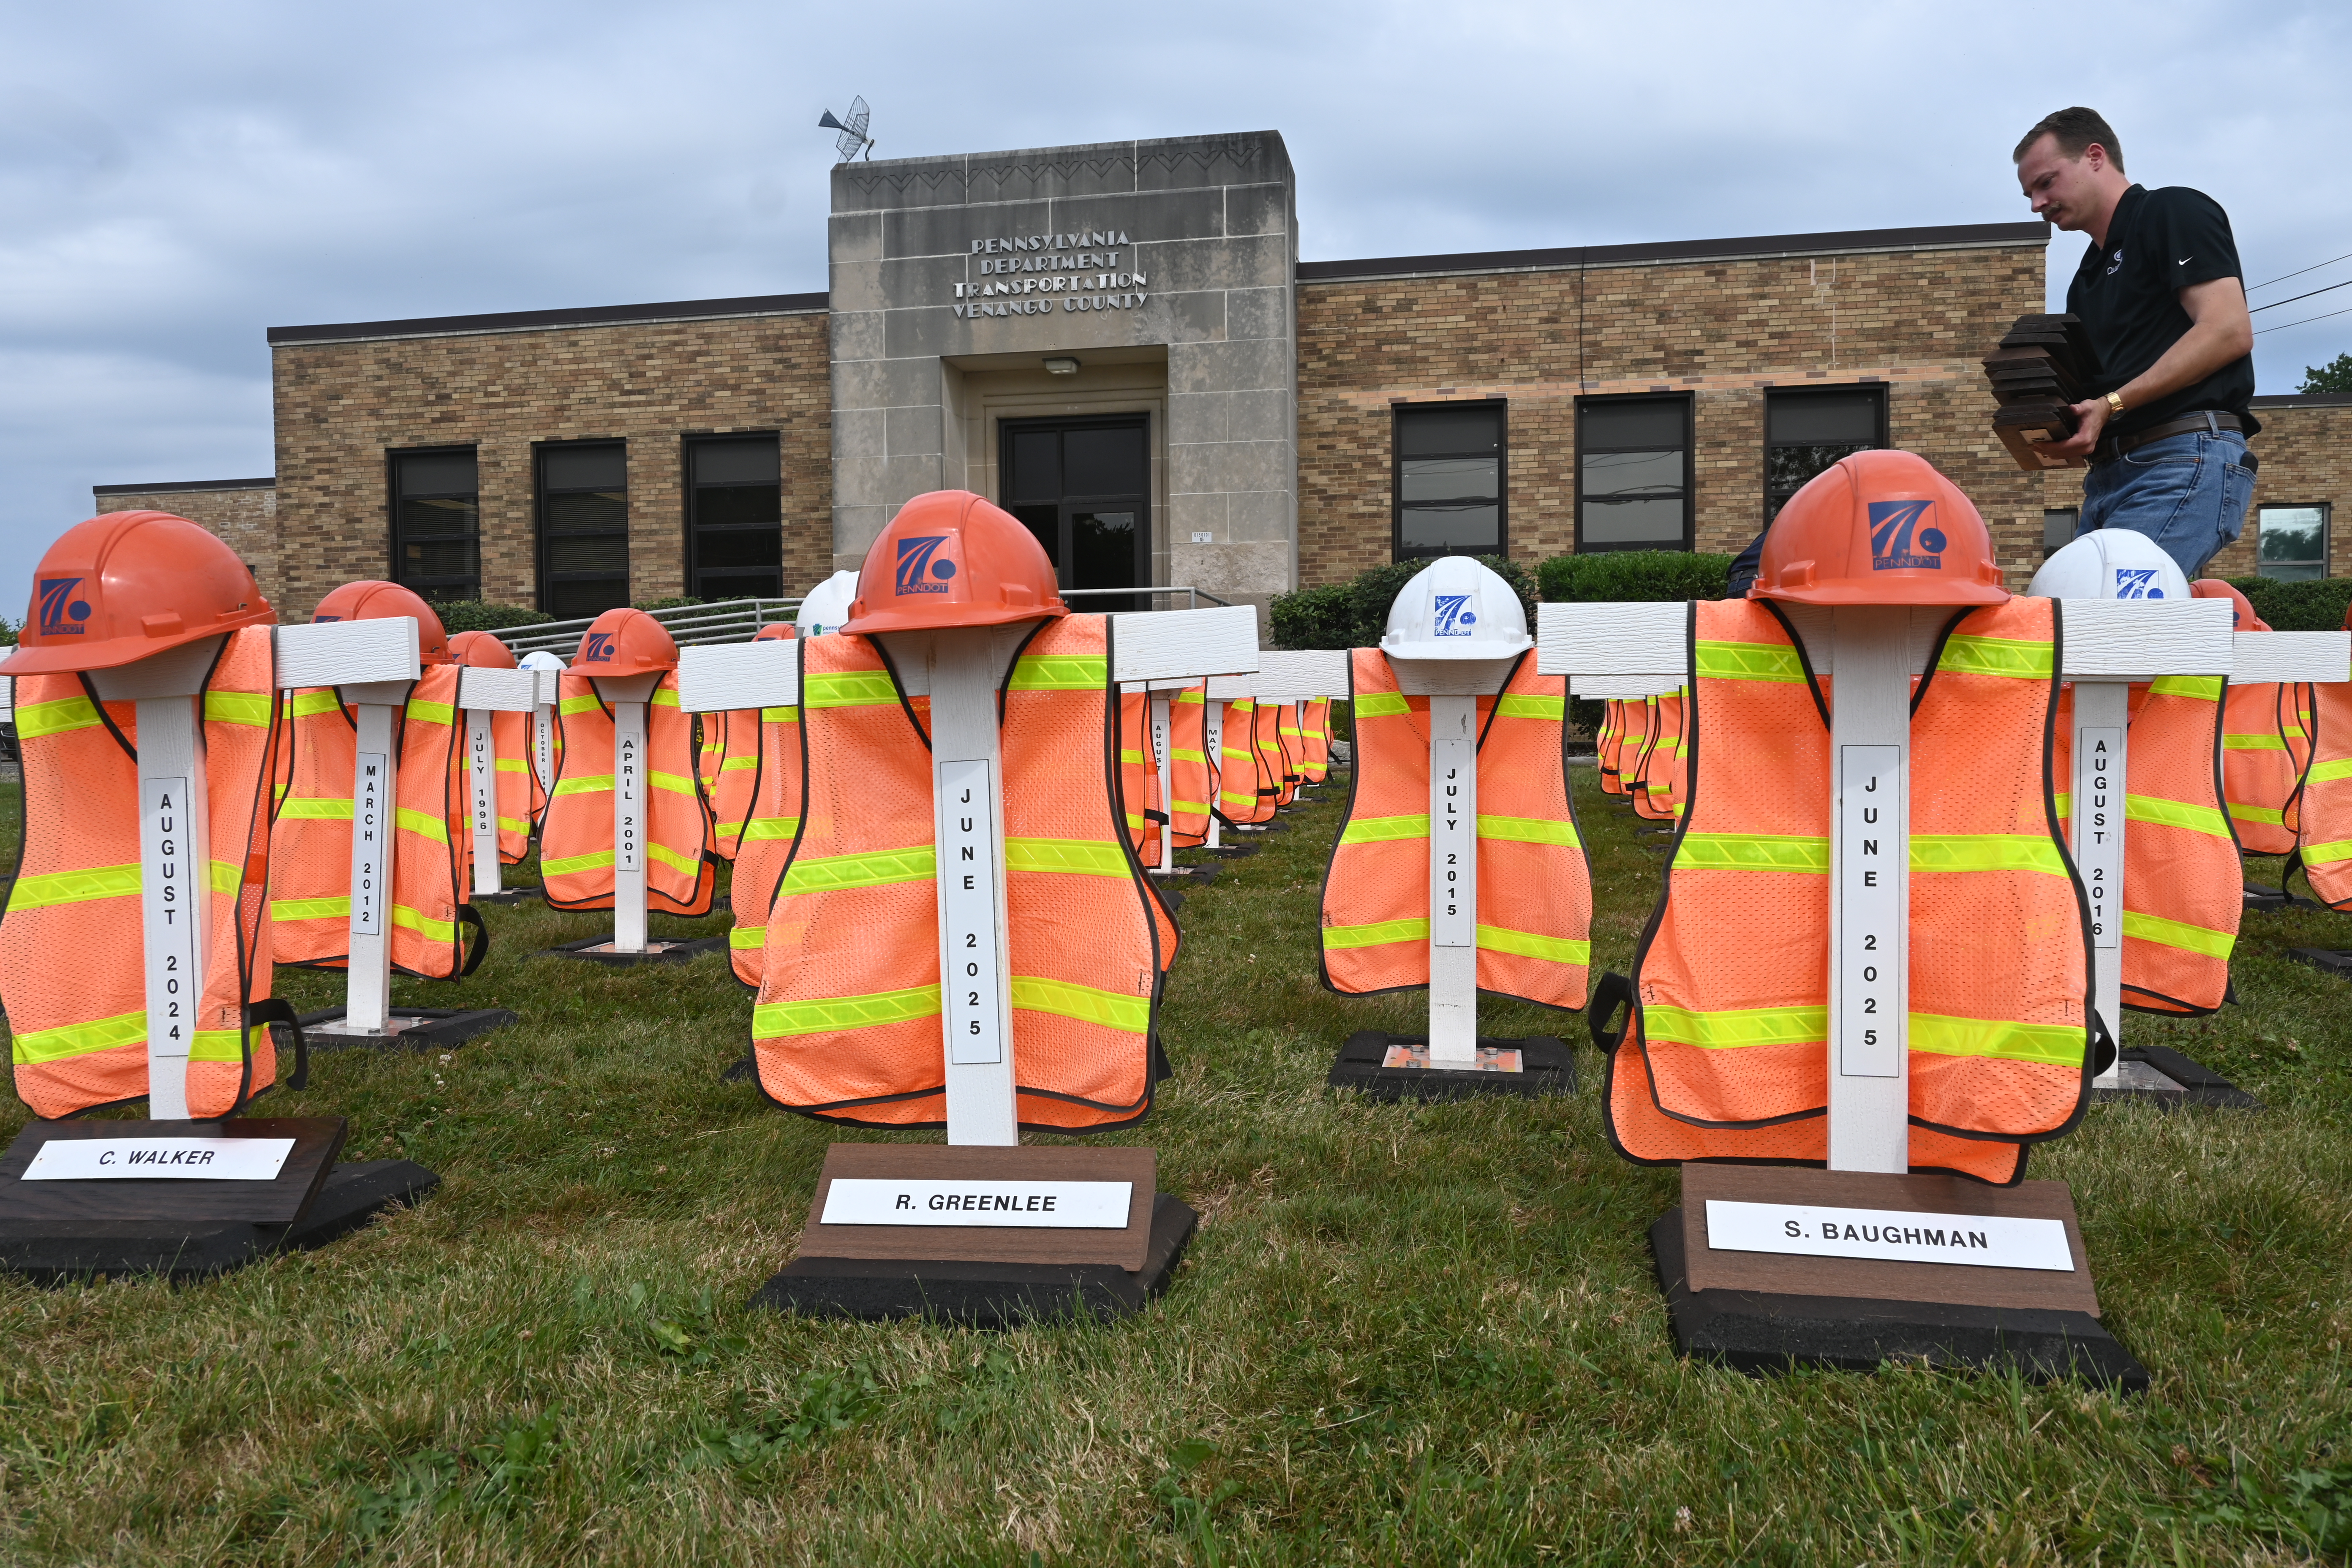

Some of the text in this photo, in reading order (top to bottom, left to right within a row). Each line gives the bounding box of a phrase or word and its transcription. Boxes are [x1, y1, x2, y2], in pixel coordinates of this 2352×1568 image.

[972, 230, 1130, 254] PENNSYLVANIA
[981, 252, 1119, 275] DEPARTMENT
[953, 271, 1146, 297] TRANSPORTATION
[953, 292, 1149, 318] VENANGO COUNTY
[1876, 557, 1940, 569] PENNDOT
[897, 583, 948, 594] PENNDOT
[41, 625, 82, 634] PENNDOT
[476, 733, 485, 774] JULY
[1209, 730, 1217, 751] MAY
[623, 740, 634, 863] APRIL 2001
[362, 765, 376, 922] MARCH 2012
[1446, 768, 1457, 915] JULY 2015
[2093, 740, 2107, 935] AUGUST 2016
[161, 794, 180, 1040] AUGUST 2024
[961, 789, 980, 1035] JUNE 2025
[1864, 776, 1878, 1045] JUNE 2025
[100, 1151, 215, 1165] C. WALKER
[896, 1194, 1057, 1211] R. GREENLEE
[1785, 1220, 1987, 1249] S. BAUGHMAN
